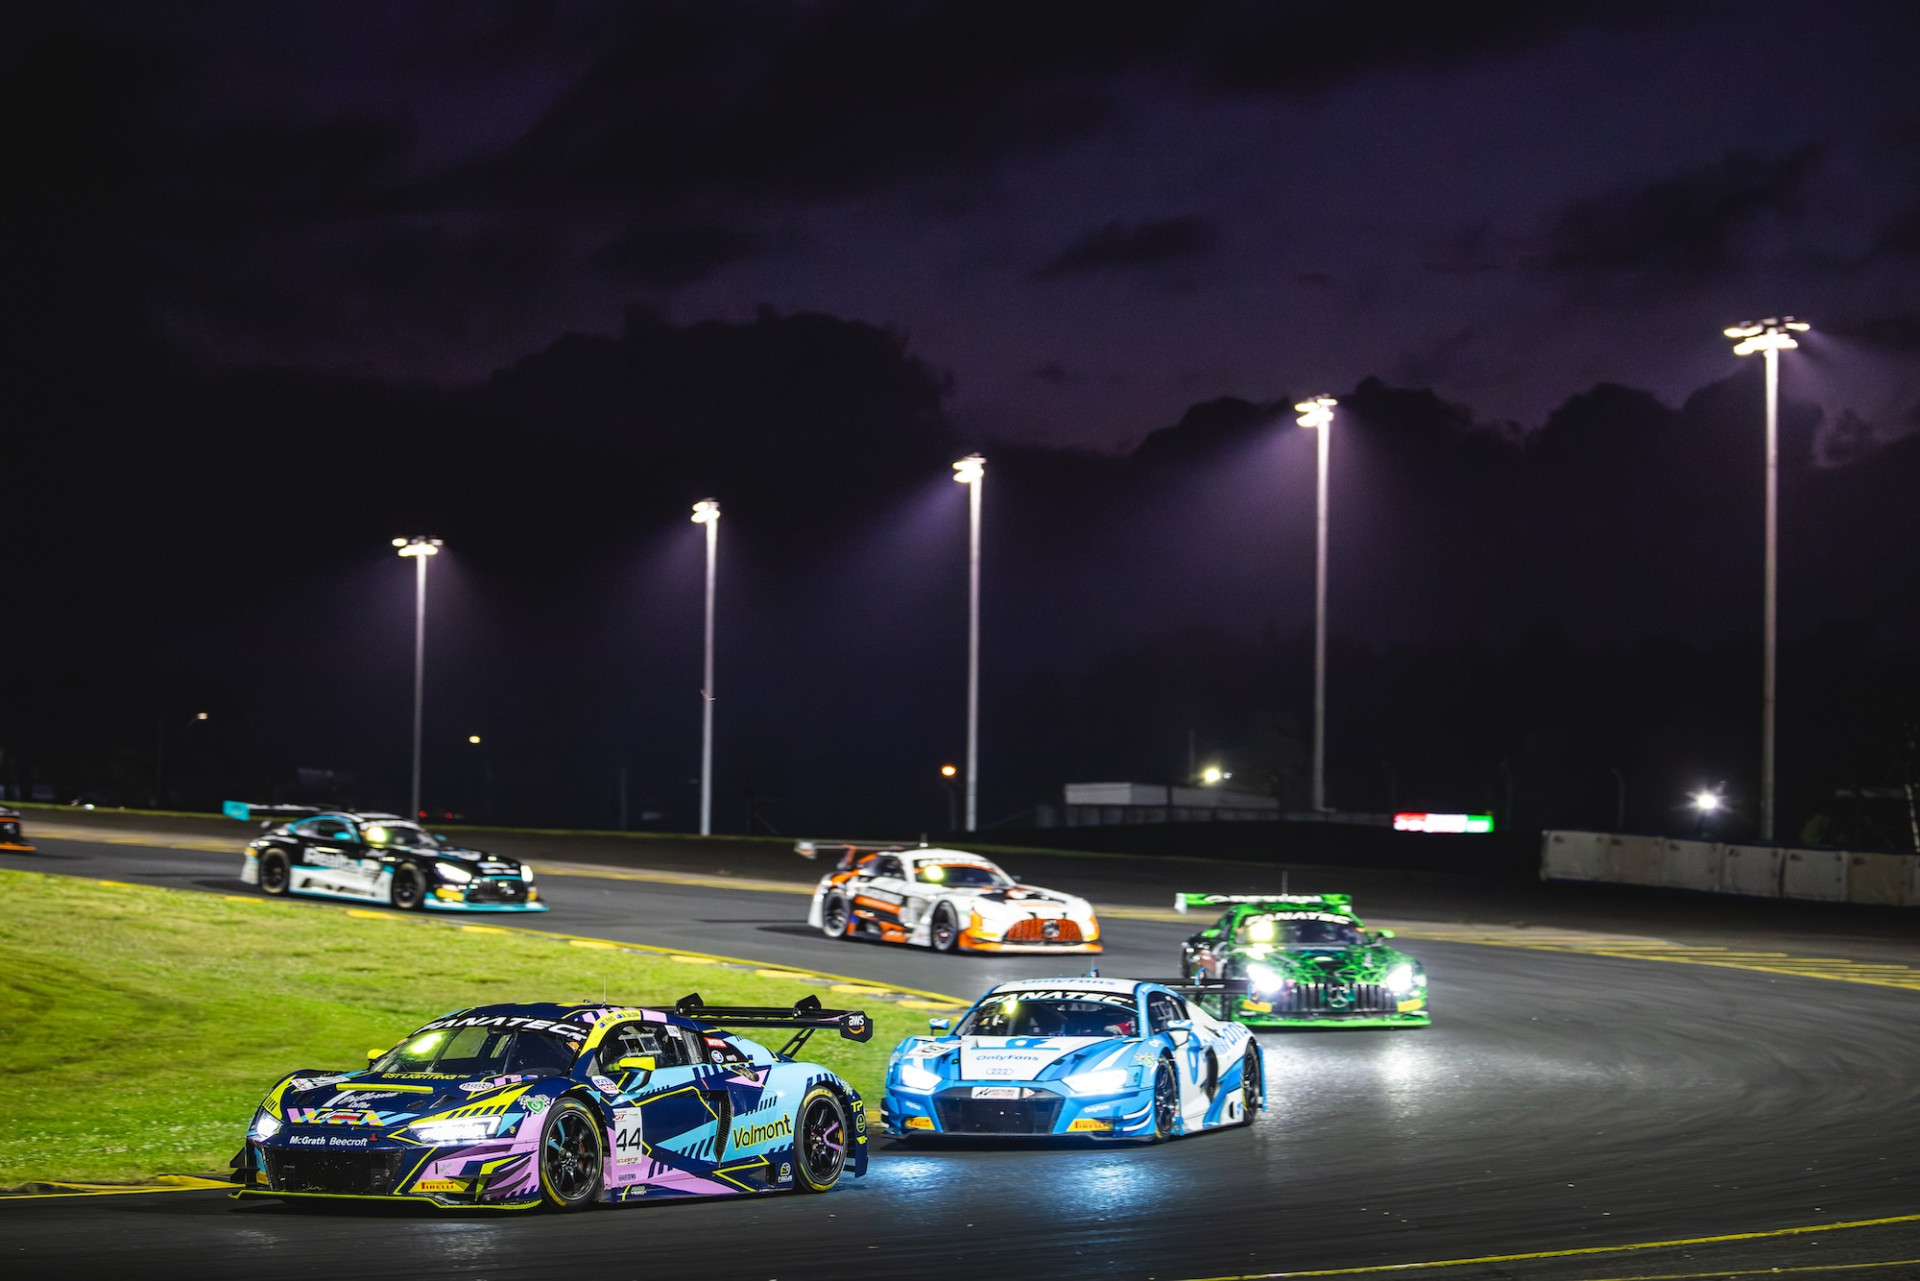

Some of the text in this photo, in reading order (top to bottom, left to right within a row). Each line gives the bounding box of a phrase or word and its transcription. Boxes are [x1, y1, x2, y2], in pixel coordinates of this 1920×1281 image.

[1245, 911, 1351, 925] FANATEC
[979, 991, 1134, 1007] FANATEC
[412, 1016, 587, 1036] FANATEC
[848, 1015, 864, 1026] aws
[976, 1054, 1039, 1062] OnlyFans
[733, 1113, 792, 1150] Valmont
[289, 1136, 369, 1147] McGrath Beecroft
[616, 1127, 641, 1151] 44
[421, 1181, 455, 1190] PIRELLI
